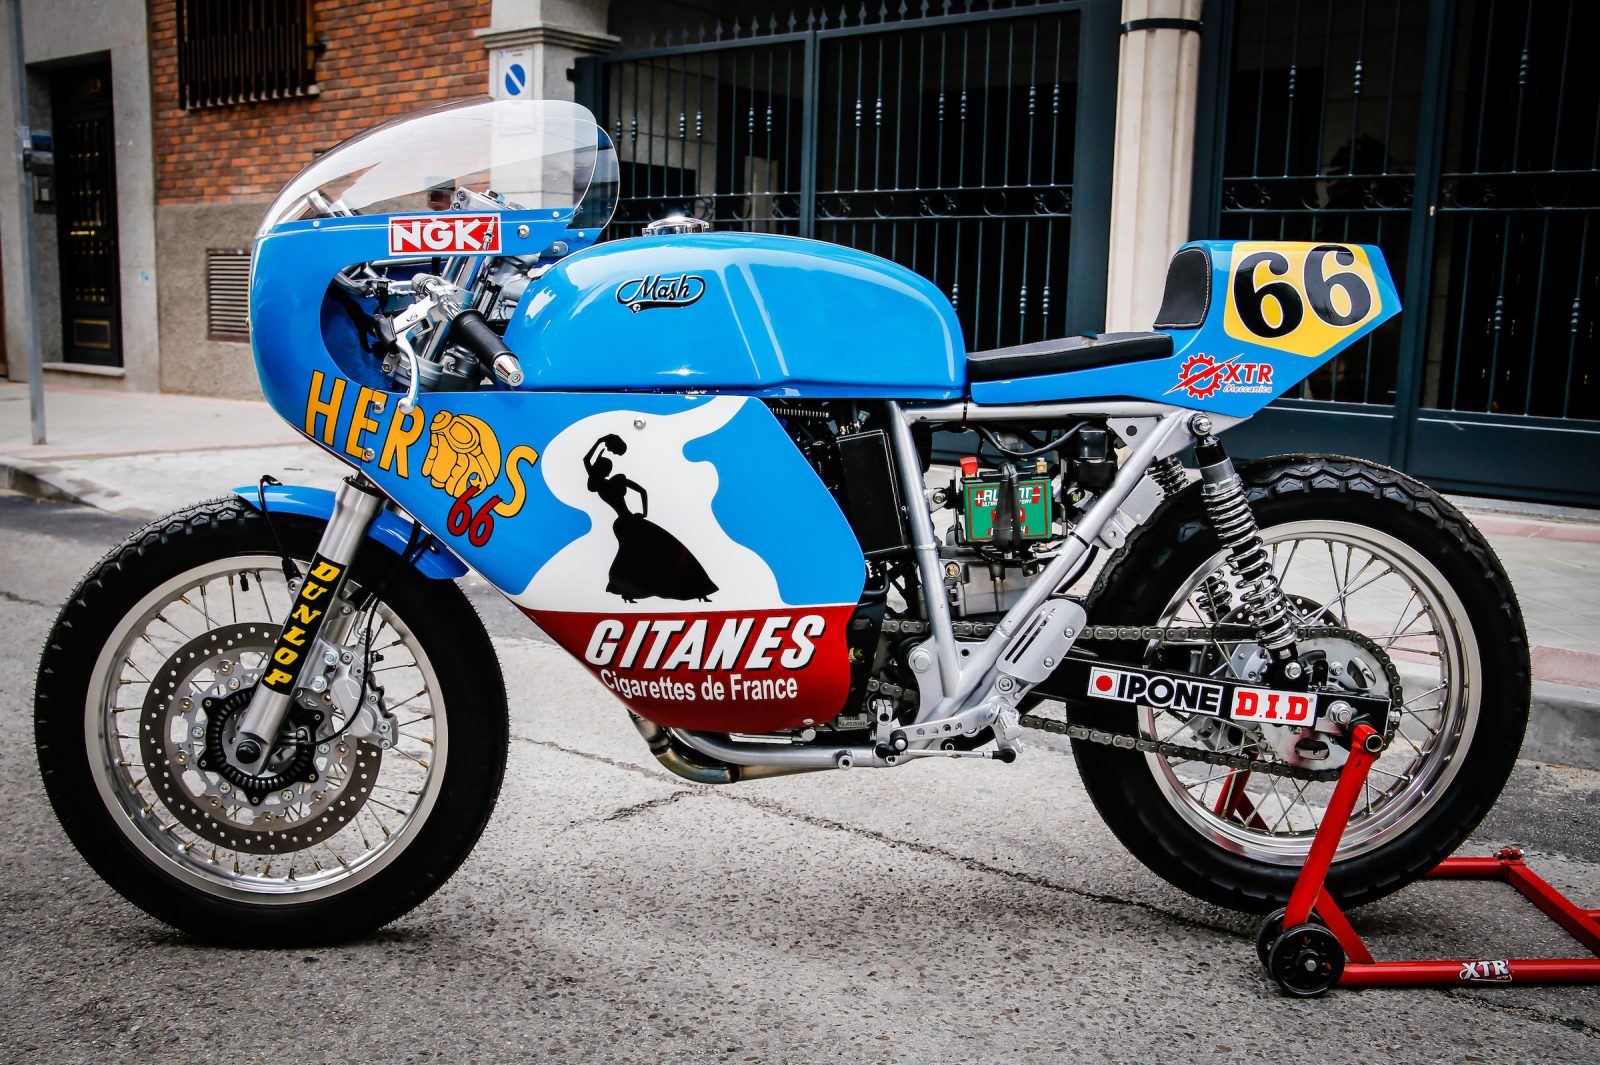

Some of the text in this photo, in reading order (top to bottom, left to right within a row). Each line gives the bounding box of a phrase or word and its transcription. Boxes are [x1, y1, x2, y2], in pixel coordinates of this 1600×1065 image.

[393, 219, 482, 251] NGK
[622, 273, 695, 303] Mash
[1233, 244, 1372, 338] 66
[1221, 363, 1274, 384] XTR
[446, 486, 505, 547] 66
[264, 561, 341, 686] DUNLOP
[584, 614, 827, 671] GITANES
[600, 667, 798, 701] Cigarettes de France
[1116, 672, 1223, 716] IPONE
[1461, 960, 1509, 980] XTR
